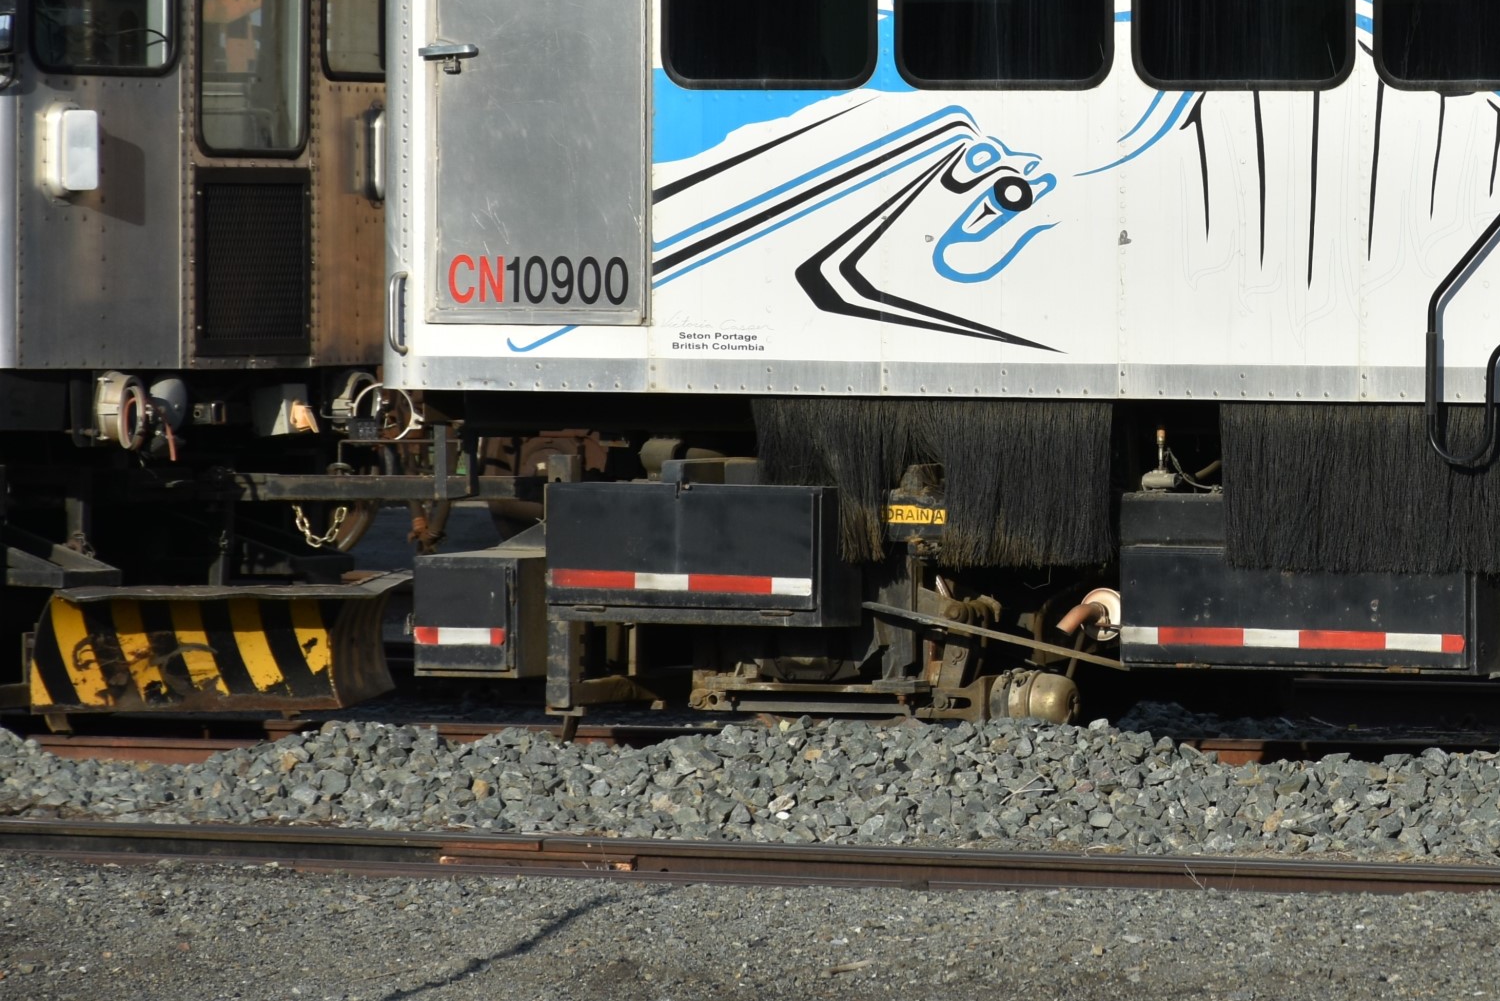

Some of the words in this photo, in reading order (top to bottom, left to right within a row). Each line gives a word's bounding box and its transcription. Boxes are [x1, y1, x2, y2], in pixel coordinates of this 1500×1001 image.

[447, 252, 629, 306] CN10900
[678, 331, 712, 341] Seton
[714, 332, 758, 343] Portage
[671, 341, 709, 351] British
[711, 342, 766, 352] Columbia
